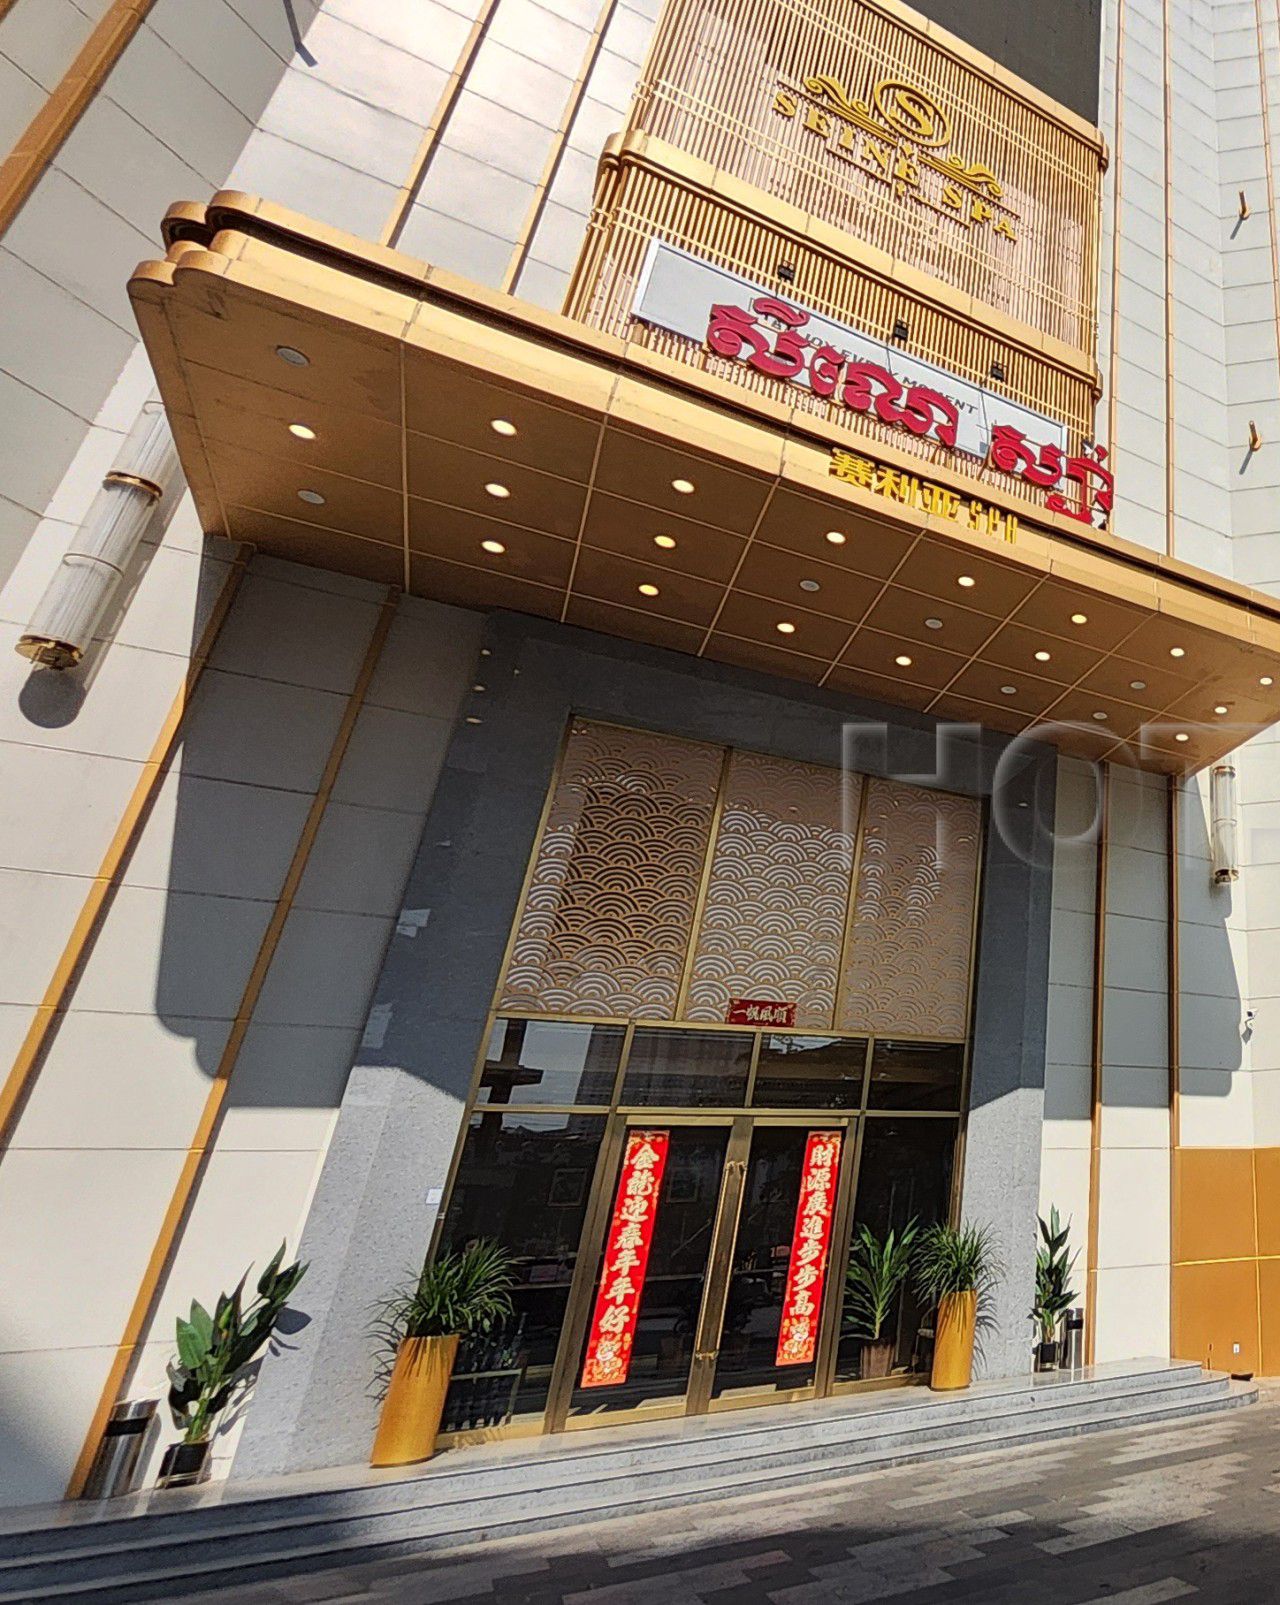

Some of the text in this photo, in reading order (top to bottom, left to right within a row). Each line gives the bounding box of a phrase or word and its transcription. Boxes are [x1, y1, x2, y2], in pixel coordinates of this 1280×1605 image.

[772, 91, 1018, 243] SEINE SPA
[902, 376, 979, 415] MENT
[829, 447, 961, 522] 赛利亚
